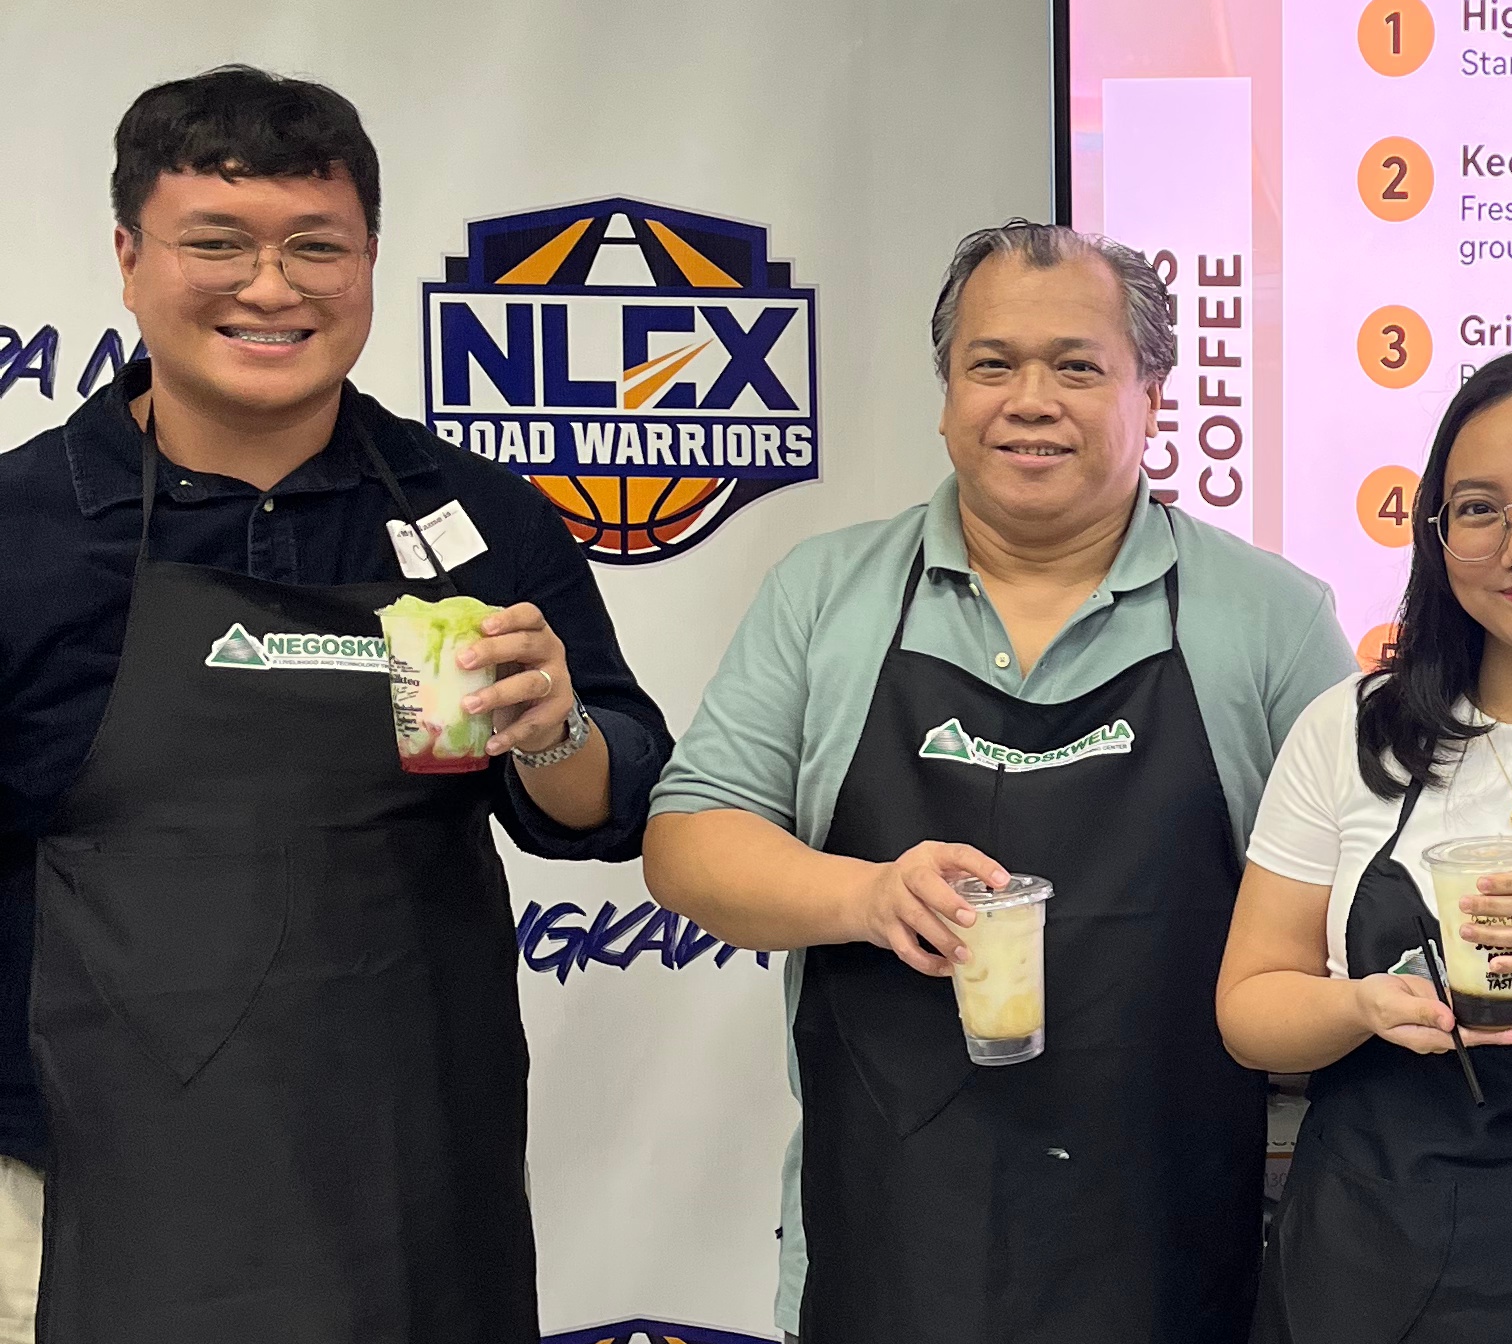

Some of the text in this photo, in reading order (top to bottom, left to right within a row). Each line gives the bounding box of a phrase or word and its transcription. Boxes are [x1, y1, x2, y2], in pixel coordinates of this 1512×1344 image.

[1383, 12, 1403, 55] 1
[1381, 155, 1409, 201] 2
[440, 302, 801, 411] NLEX
[1380, 324, 1410, 369] 3
[1198, 253, 1243, 507] COFFEE
[569, 421, 813, 468] WARRIORS
[1378, 486, 1409, 526] 4
[975, 722, 1131, 766] NEGOSKWELA
